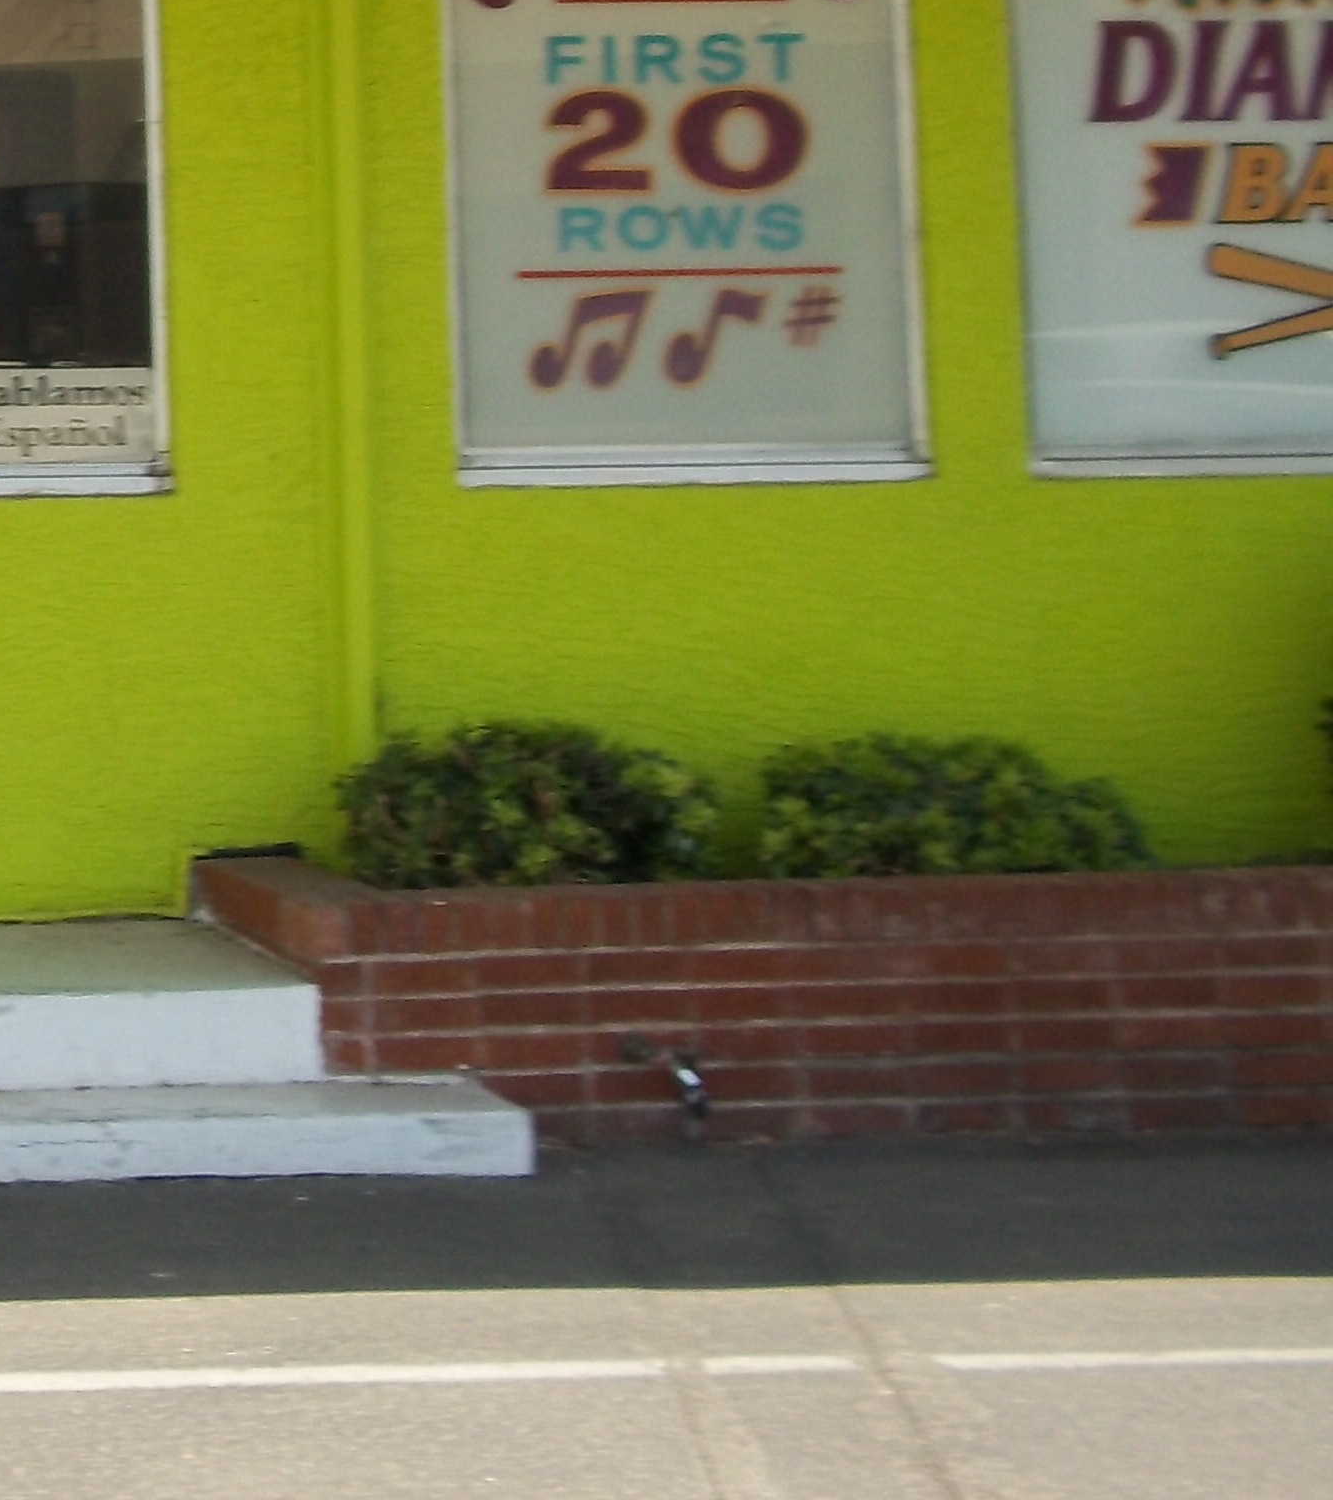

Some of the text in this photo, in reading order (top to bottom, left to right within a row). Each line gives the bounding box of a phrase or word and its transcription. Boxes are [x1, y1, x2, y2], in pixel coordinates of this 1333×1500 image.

[544, 32, 807, 86] FIRST
[542, 87, 813, 195] 20
[556, 204, 807, 253] ROWS
